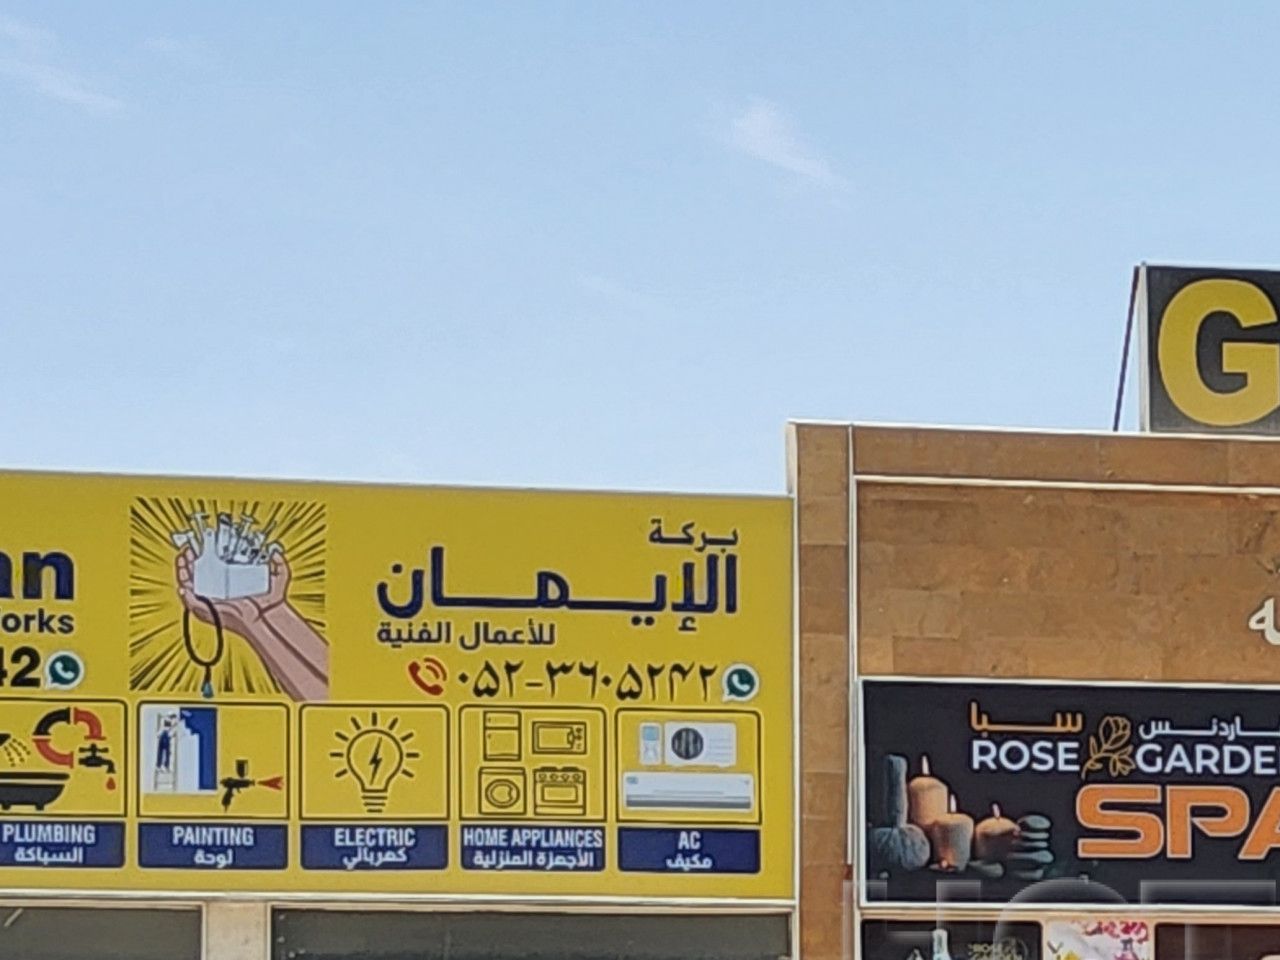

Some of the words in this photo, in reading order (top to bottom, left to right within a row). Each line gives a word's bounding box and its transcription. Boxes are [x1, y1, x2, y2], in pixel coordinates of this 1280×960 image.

[648, 518, 740, 554] بركة
[376, 545, 738, 632] الإيمان
[376, 620, 452, 649] الفنية
[458, 617, 557, 651] للأعمال
[0, 645, 42, 688] 2
[971, 739, 1081, 772] ROSE
[1, 823, 96, 844] PLUMBING
[172, 826, 255, 847] PAINTING
[334, 827, 416, 847] ELECTRIC
[463, 827, 509, 847] HOME
[510, 829, 603, 848] APPLIANCES
[677, 831, 702, 851] AC
[14, 848, 84, 866] السباكة
[193, 848, 234, 868] لوحة
[665, 851, 714, 872] مكيف
